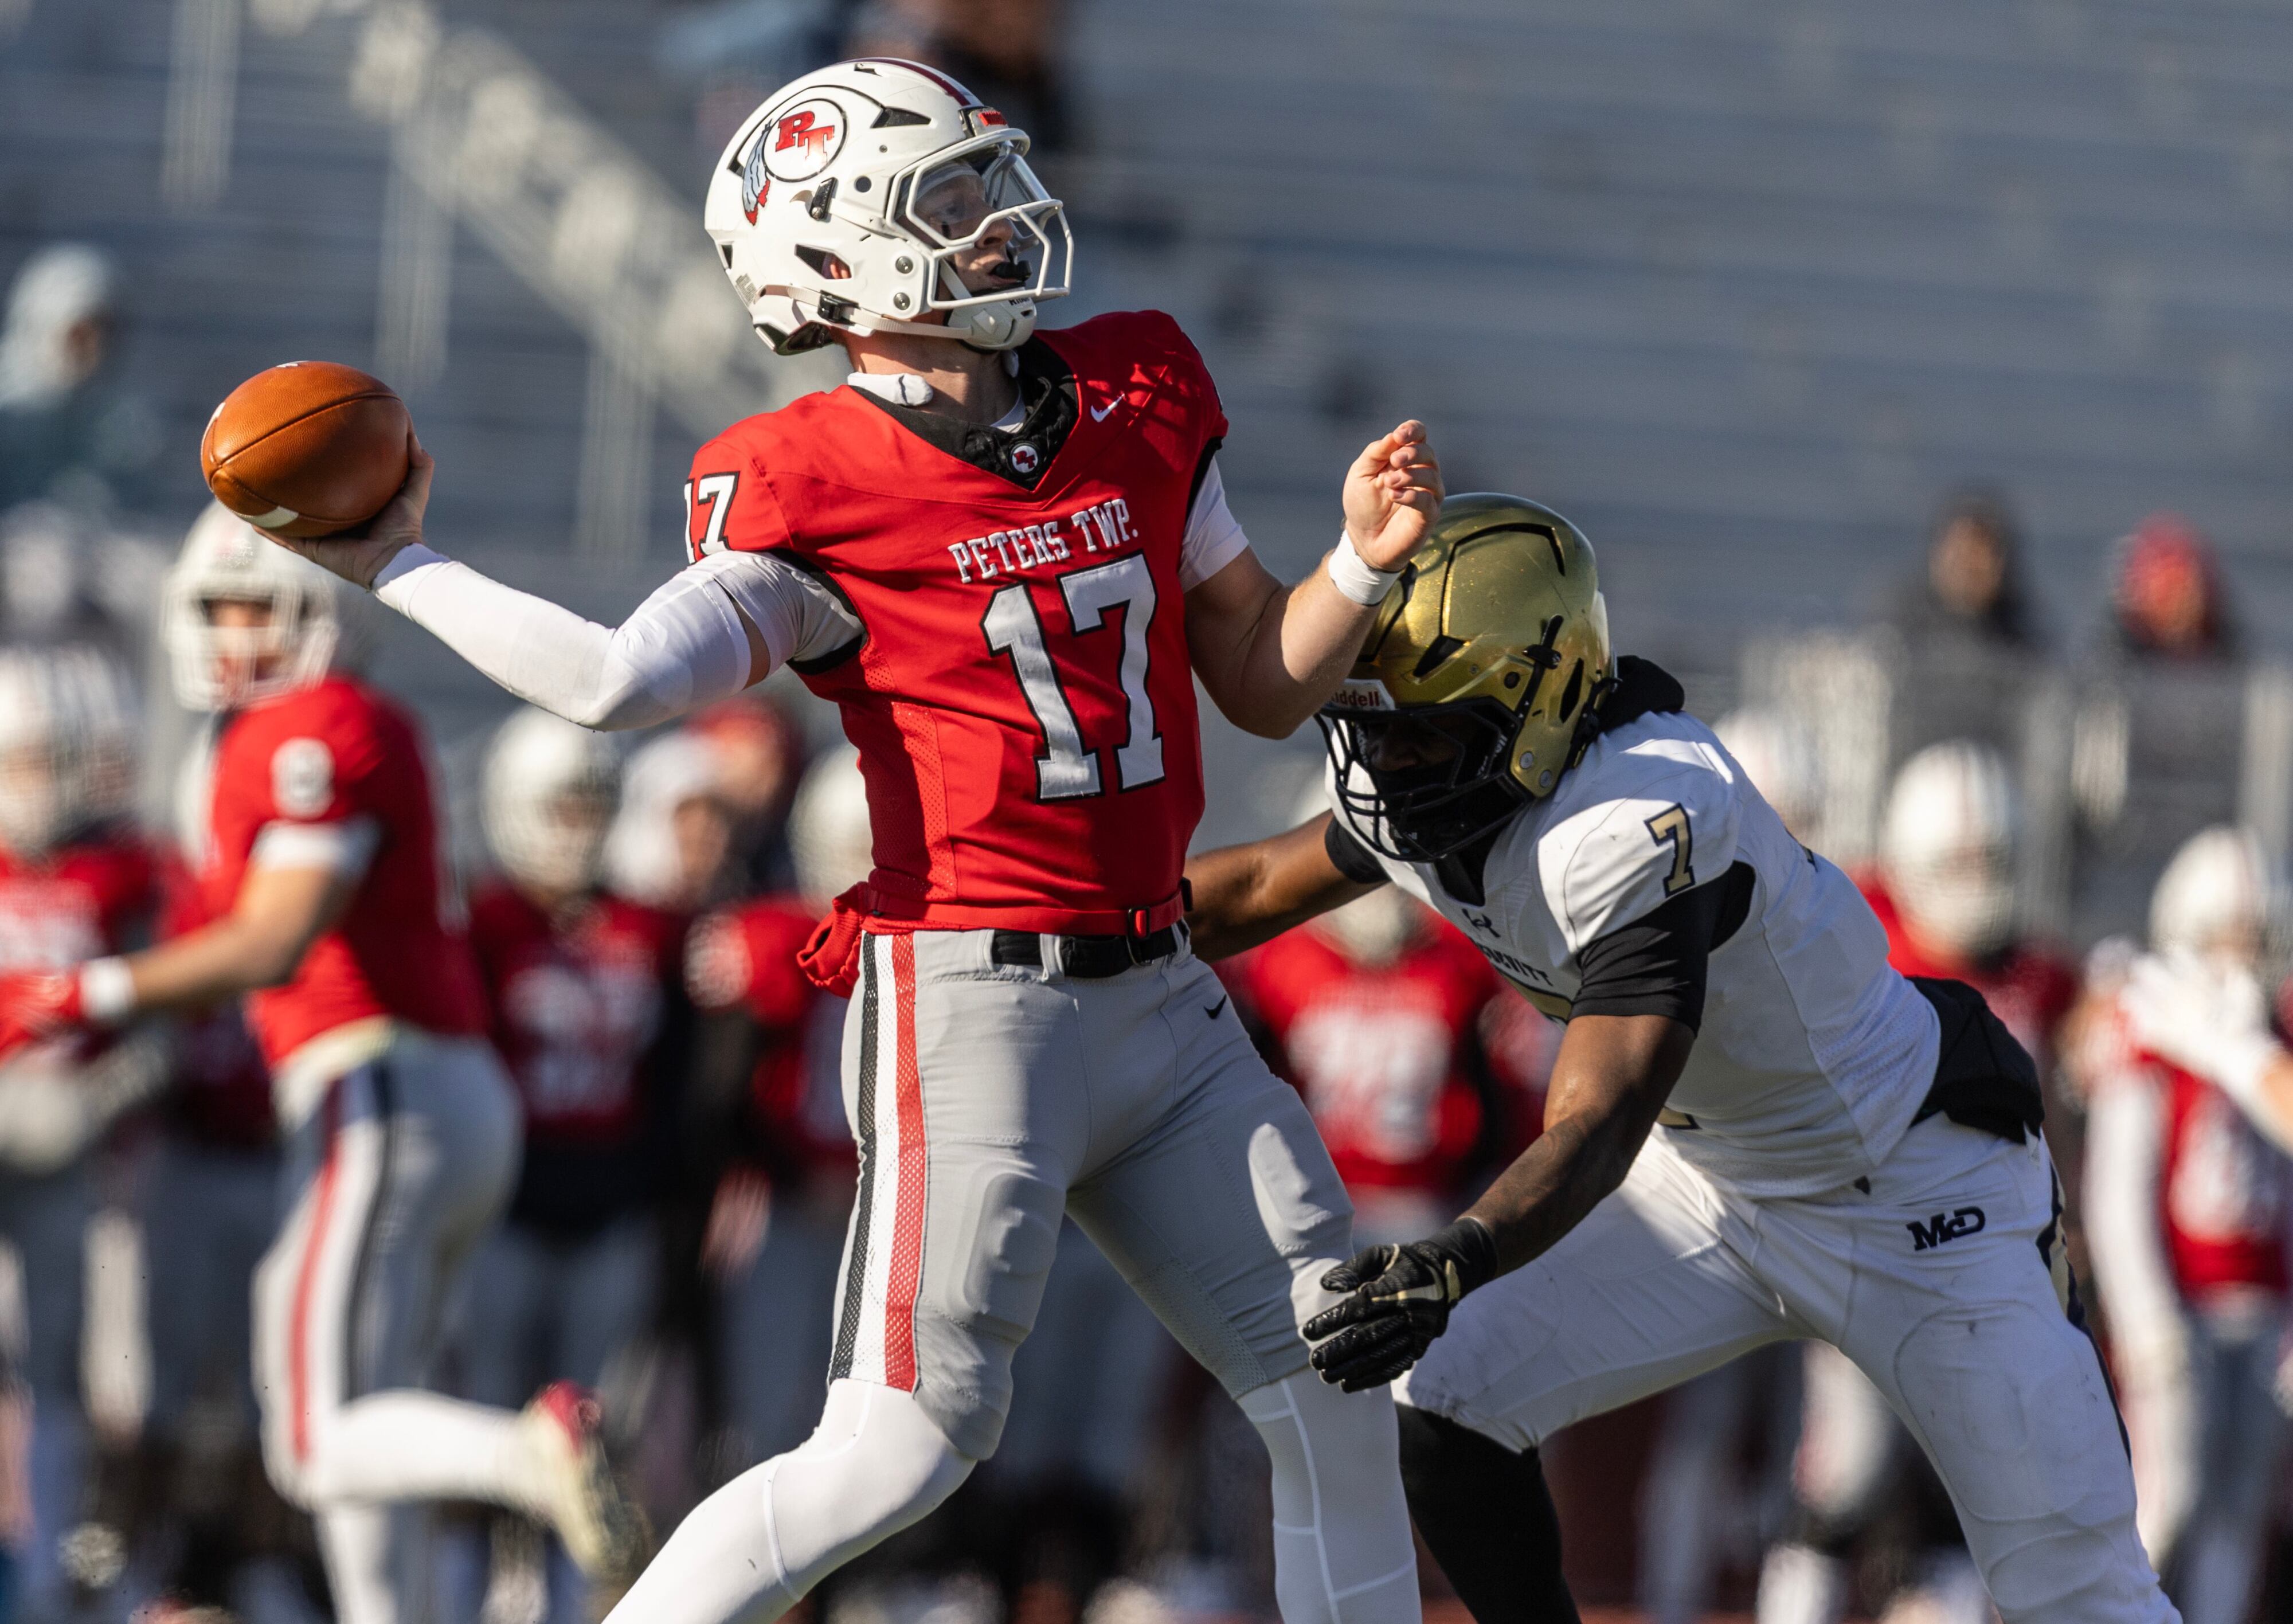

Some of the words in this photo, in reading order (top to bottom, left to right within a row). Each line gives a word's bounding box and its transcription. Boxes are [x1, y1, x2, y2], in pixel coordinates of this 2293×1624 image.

[775, 110, 835, 163] PT
[948, 521, 1071, 583] PETERS
[1070, 498, 1138, 552] TWP.
[980, 549, 1166, 804] 17
[1329, 690, 1380, 707] iddell
[1643, 802, 1696, 899] 7
